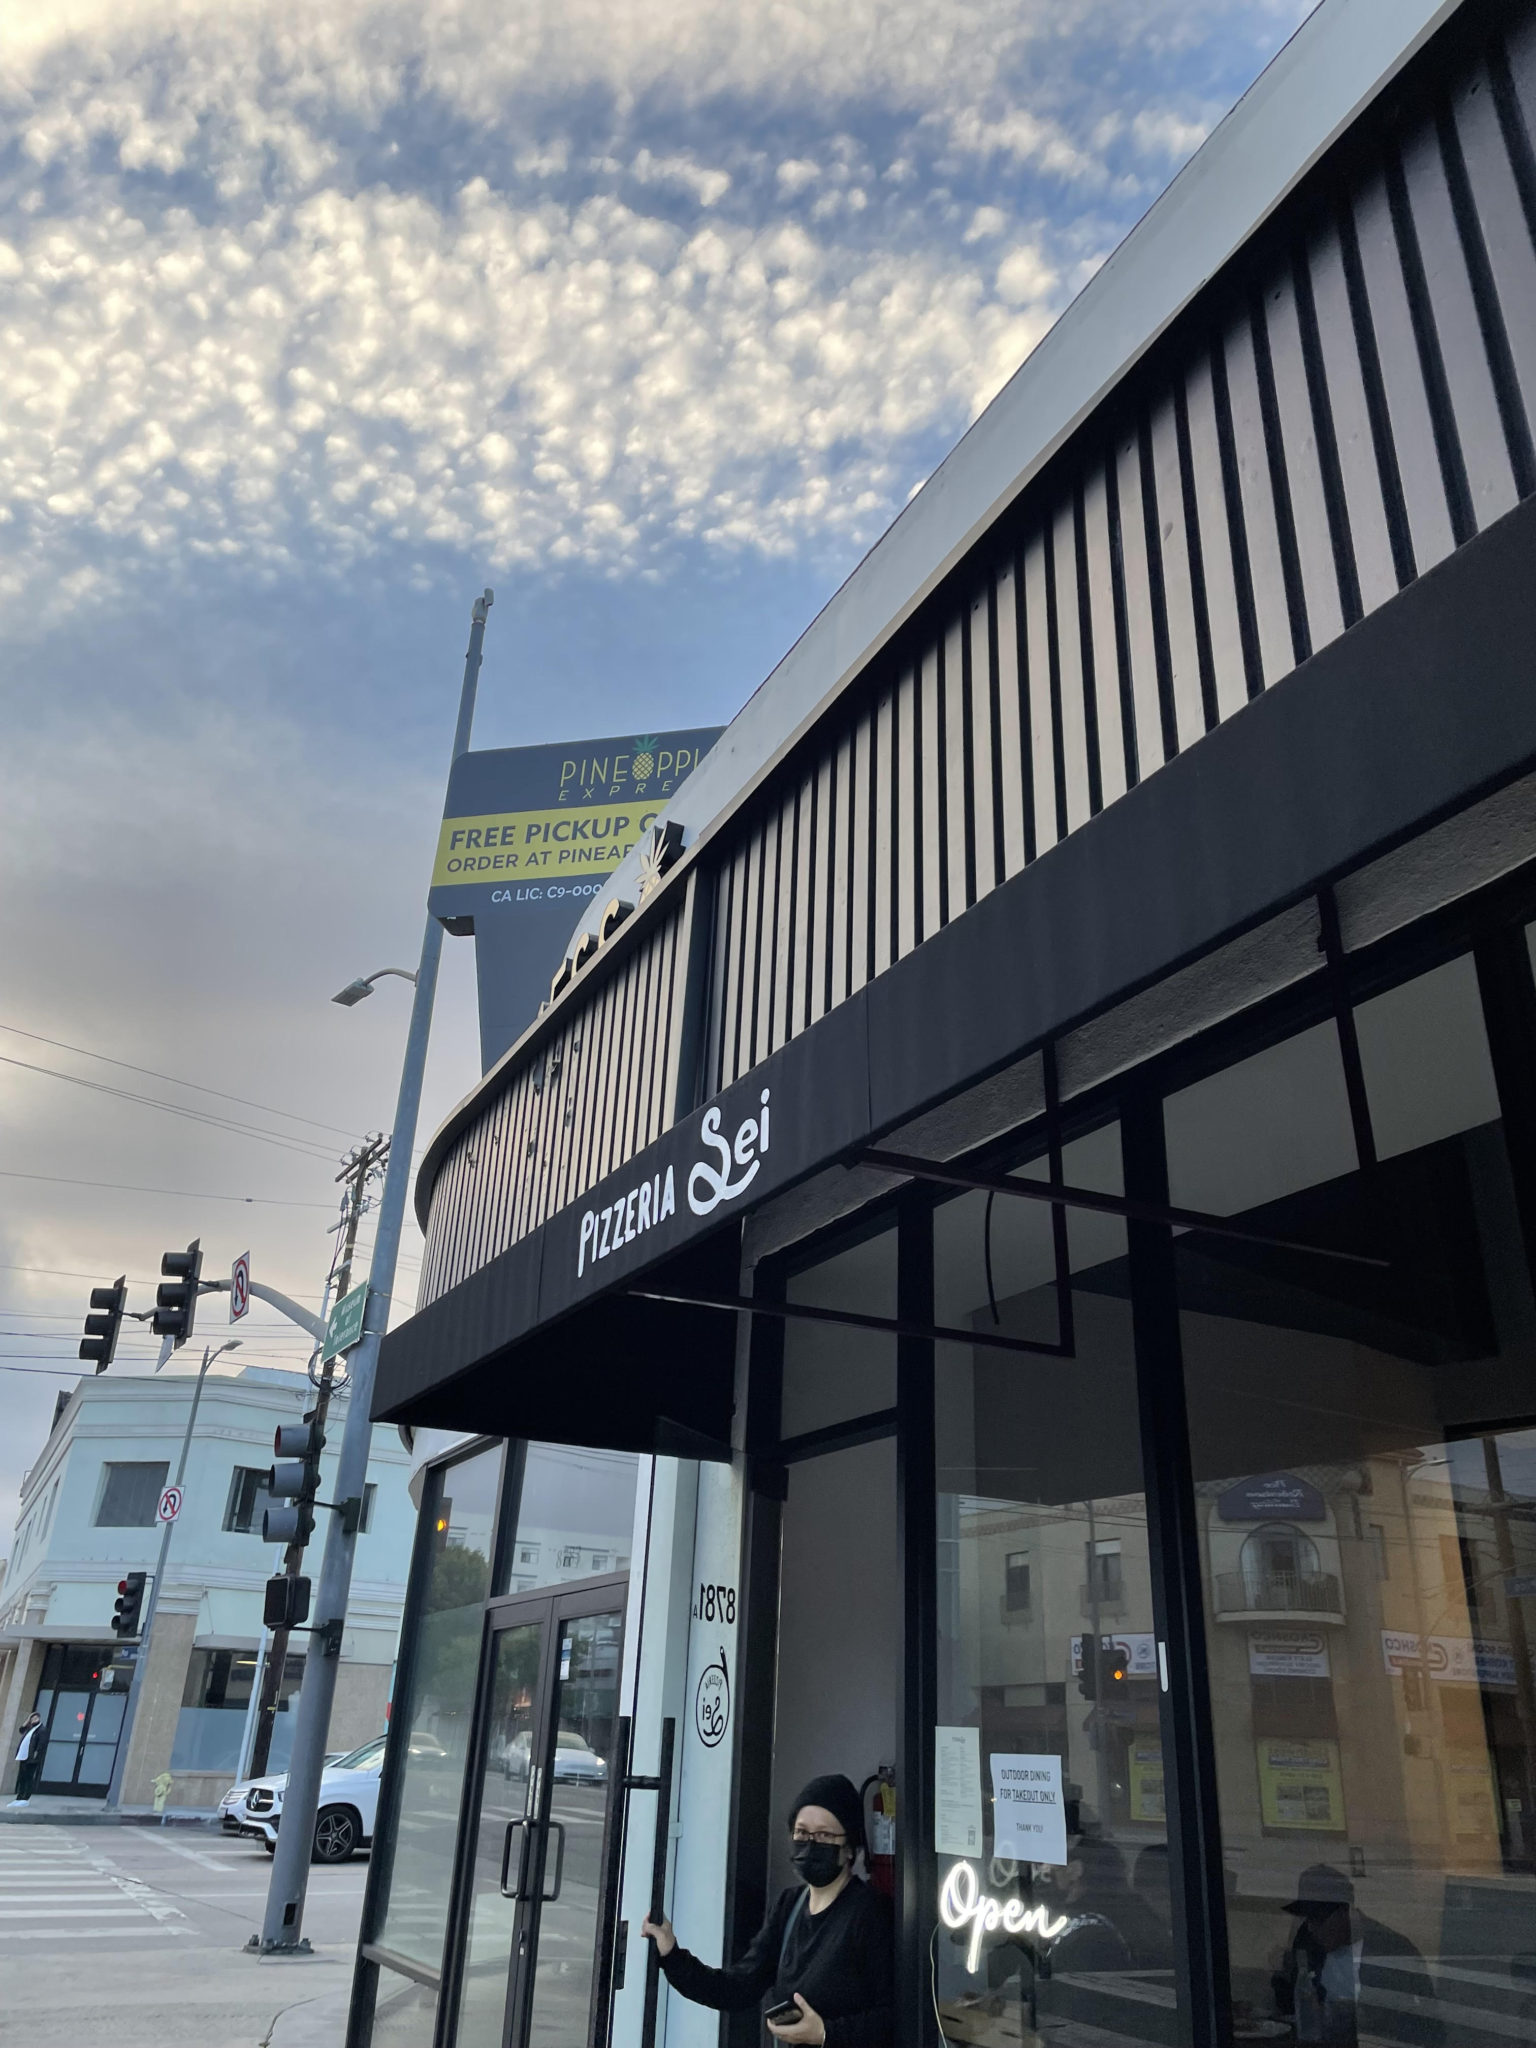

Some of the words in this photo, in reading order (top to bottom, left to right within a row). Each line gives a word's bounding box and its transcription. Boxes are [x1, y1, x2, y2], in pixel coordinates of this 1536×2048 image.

[558, 780, 673, 801] EXPRE
[450, 825, 515, 850] FREE
[525, 816, 630, 845] PICKUP
[447, 853, 518, 873] ORDER
[525, 851, 550, 867] AT
[558, 844, 633, 864] PINEAP
[491, 890, 512, 903] CA
[516, 887, 543, 901] LIC:
[547, 883, 604, 899] C9-000
[577, 1165, 675, 1278] PIZZERIA
[688, 1088, 770, 1216] Sei
[1000, 1769, 1029, 1781] OUTDOOR
[1030, 1771, 1051, 1782] DINING
[1000, 1788, 1012, 1799] FOR
[1012, 1789, 1039, 1802] TAKEOUT
[1040, 1790, 1056, 1803] ONLY
[1016, 1822, 1032, 1832] THANK
[940, 1860, 1068, 1974] Open
